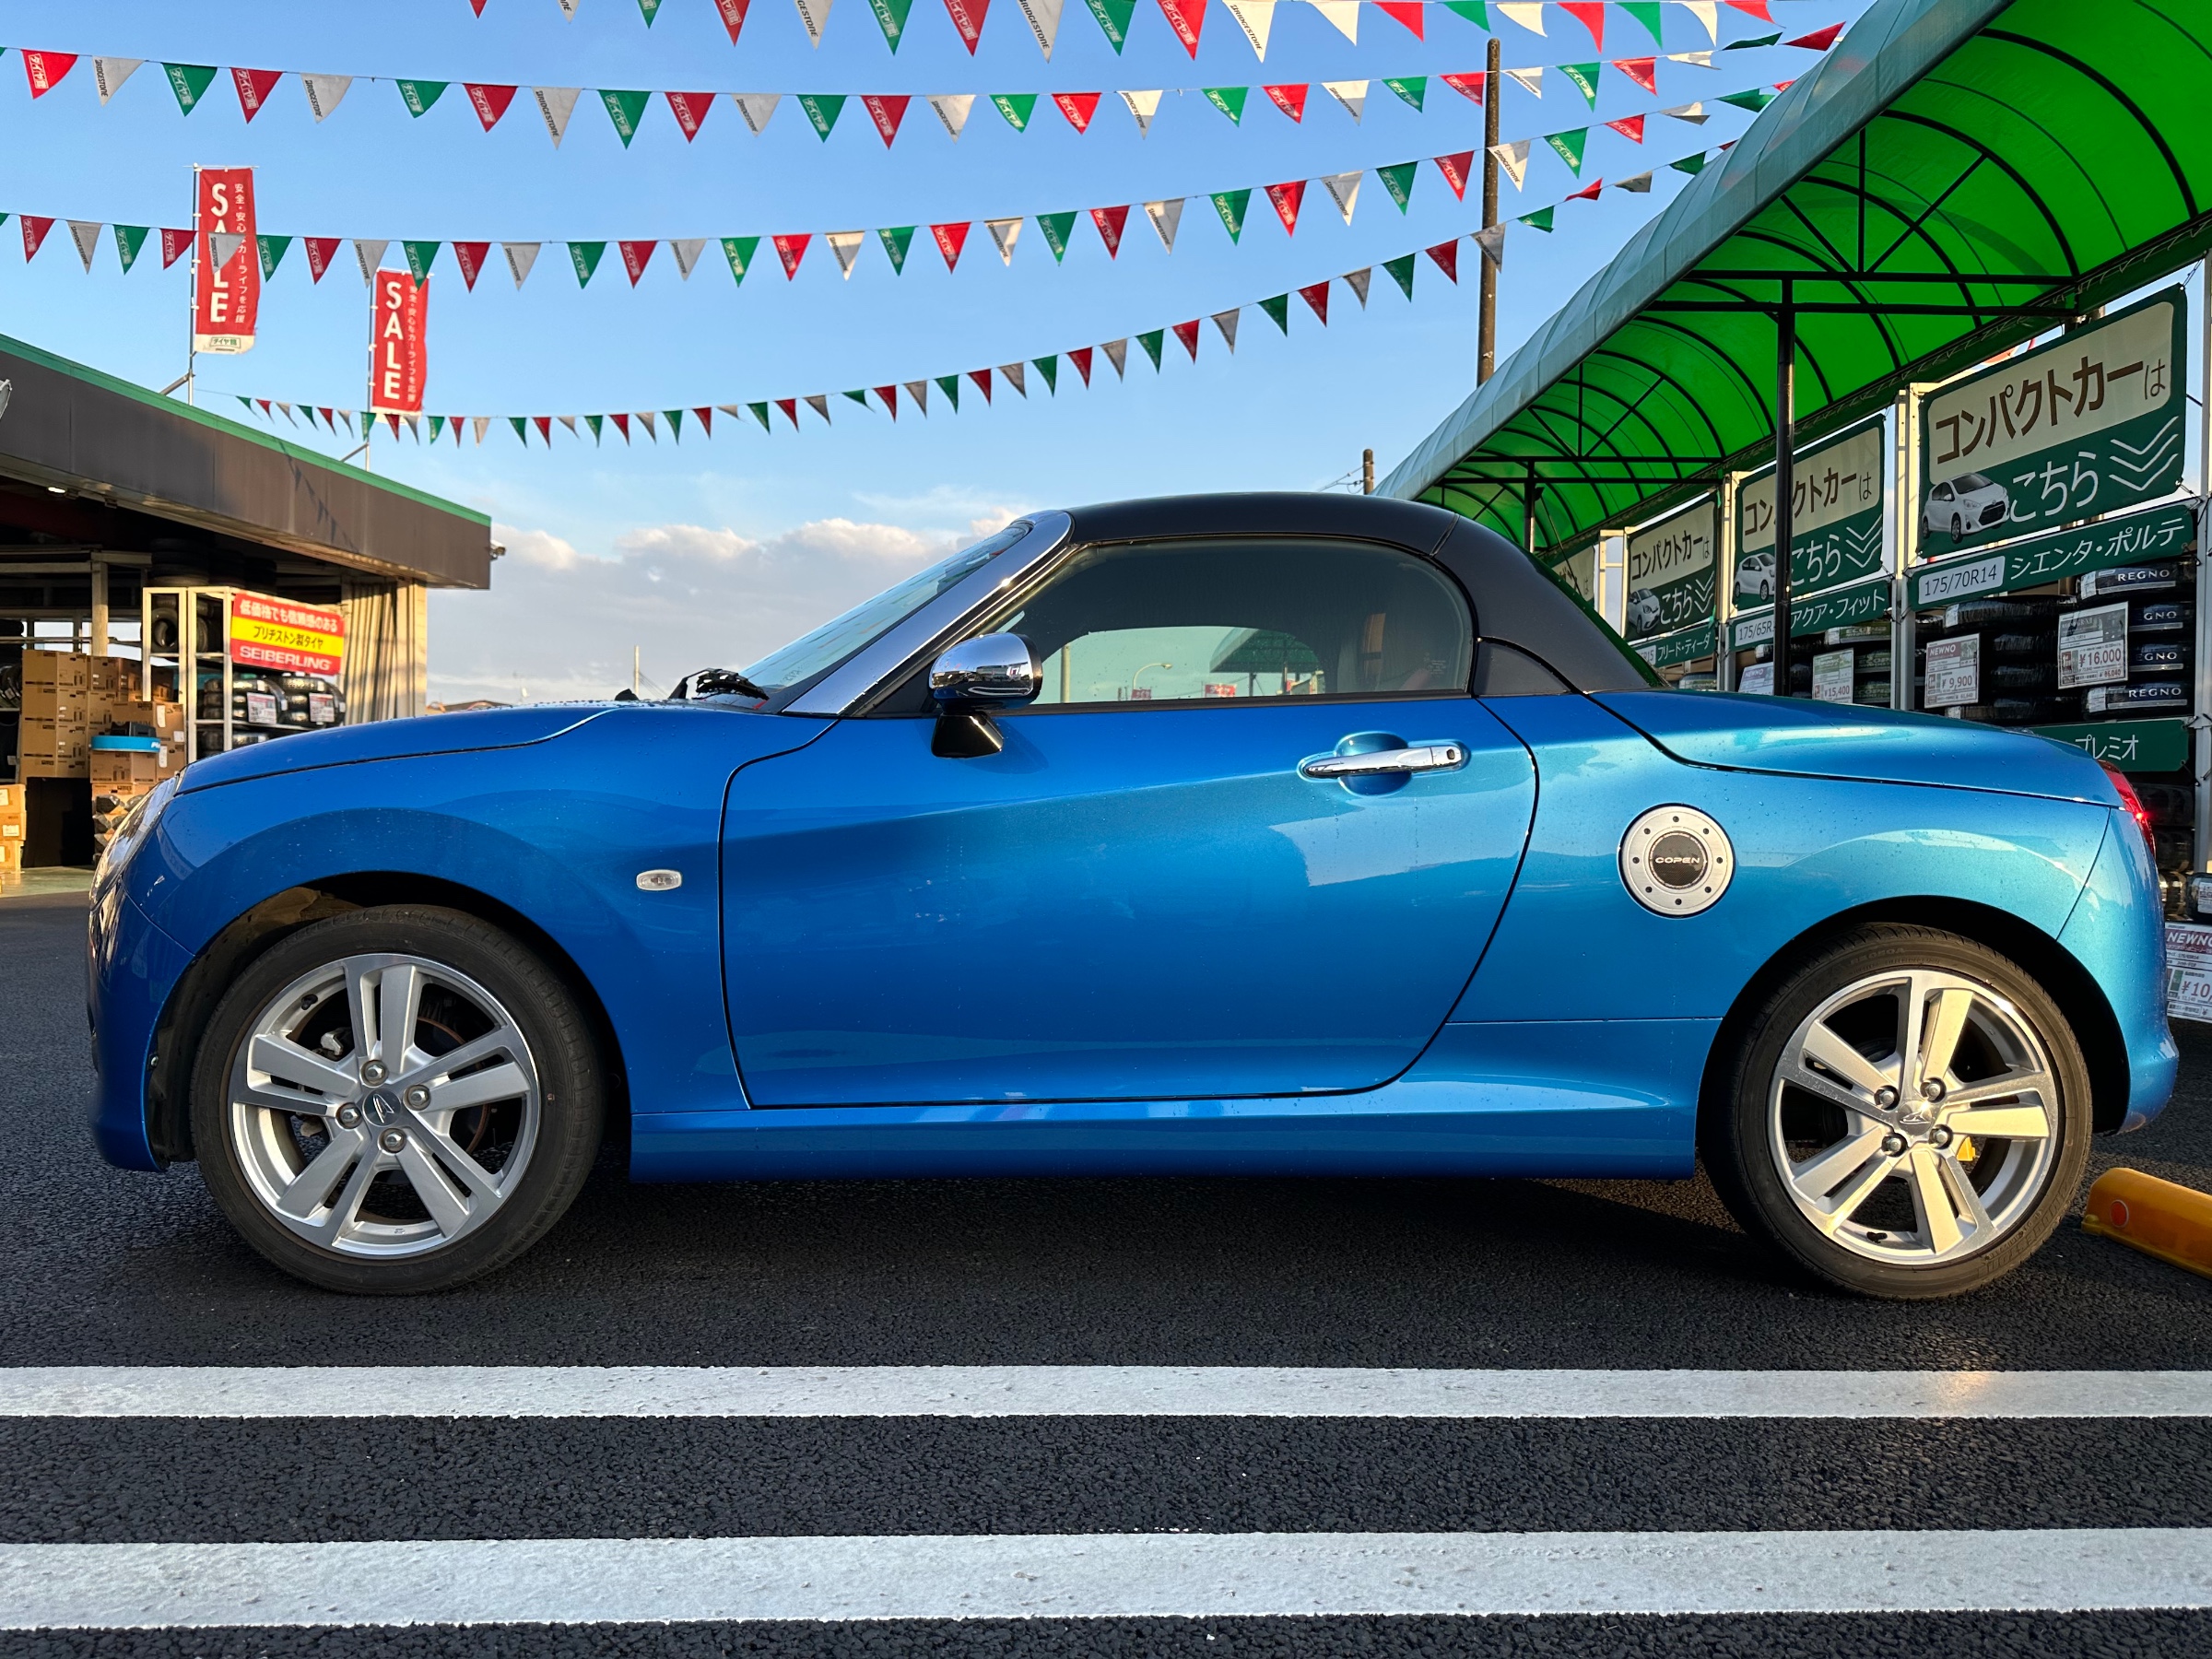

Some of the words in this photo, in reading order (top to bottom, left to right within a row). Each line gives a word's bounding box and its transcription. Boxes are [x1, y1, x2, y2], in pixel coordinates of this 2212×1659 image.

[1230, 4, 1263, 51] BRIDGESTONE
[95, 59, 109, 98] BRIDGESTONE
[536, 90, 559, 136] BRIDGESTONE
[234, 182, 248, 324] 安全・安心カーライフを応援
[383, 281, 404, 400] SALE
[1936, 356, 2166, 465] コンパクトカーは
[1744, 467, 1872, 536] コンクトカーは
[2009, 451, 2099, 523] こちら
[1631, 530, 1711, 581] コンパクトカーは
[2010, 517, 2185, 581] シエンタ・ポルテ
[1924, 564, 1997, 597] 175/70R14
[2117, 568, 2171, 582] REGNO
[1660, 582, 1693, 624] こちら
[1790, 589, 1885, 629] アクア・フィット
[2143, 610, 2178, 621] GNO
[1657, 632, 1712, 662] フリード・ティーダ
[1738, 621, 1775, 641] 175/65R
[240, 645, 332, 671] SEIBERLING
[1929, 643, 1957, 657] NEWNO
[2079, 648, 2122, 668] ¥16,000
[2136, 651, 2178, 662] EGNO
[2128, 687, 2183, 698] REGNO
[2075, 735, 2139, 760] プレミオ
[1654, 856, 1700, 865] COPEN
